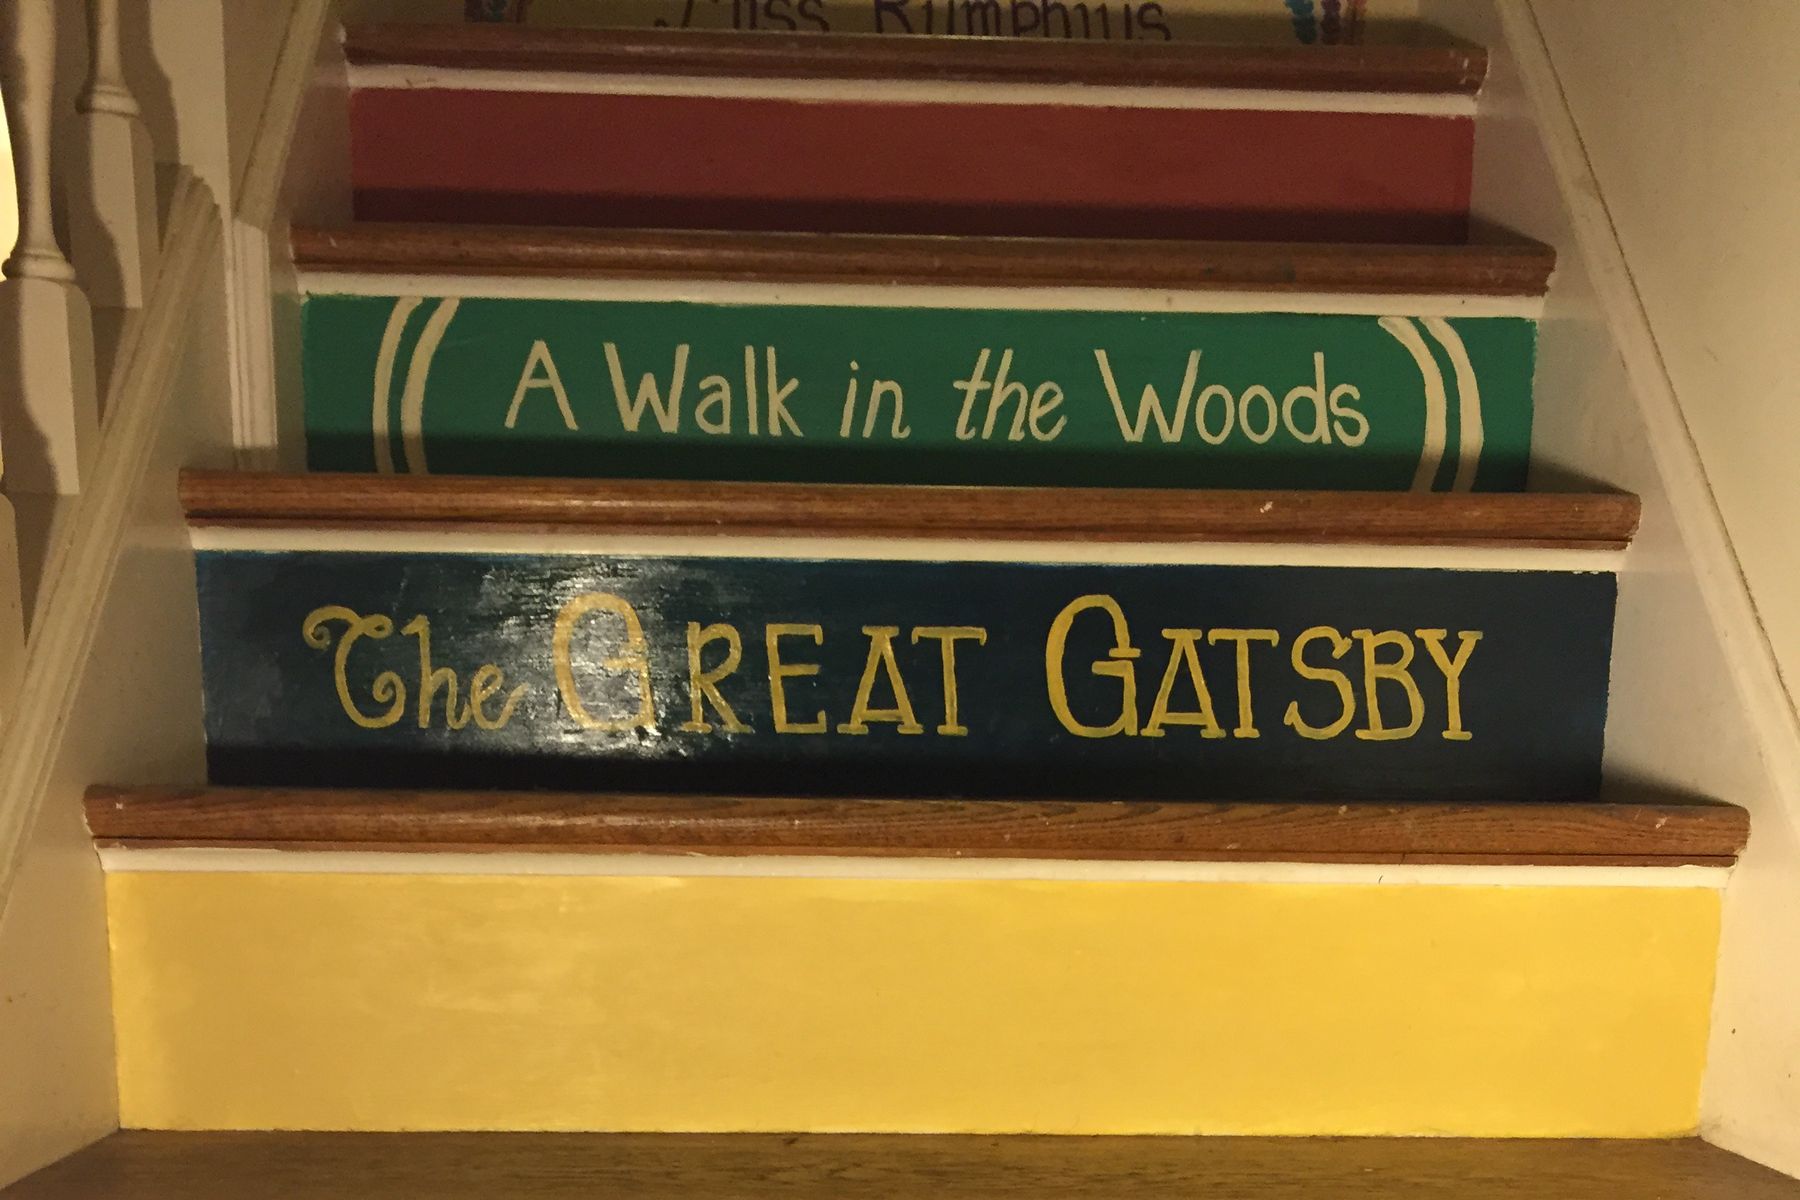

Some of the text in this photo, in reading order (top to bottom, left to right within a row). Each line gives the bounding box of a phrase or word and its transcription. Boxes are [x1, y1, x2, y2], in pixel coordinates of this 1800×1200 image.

[504, 340, 1371, 447] A Walk in the Woods
[303, 592, 1484, 740] The GREAT GATSBY
